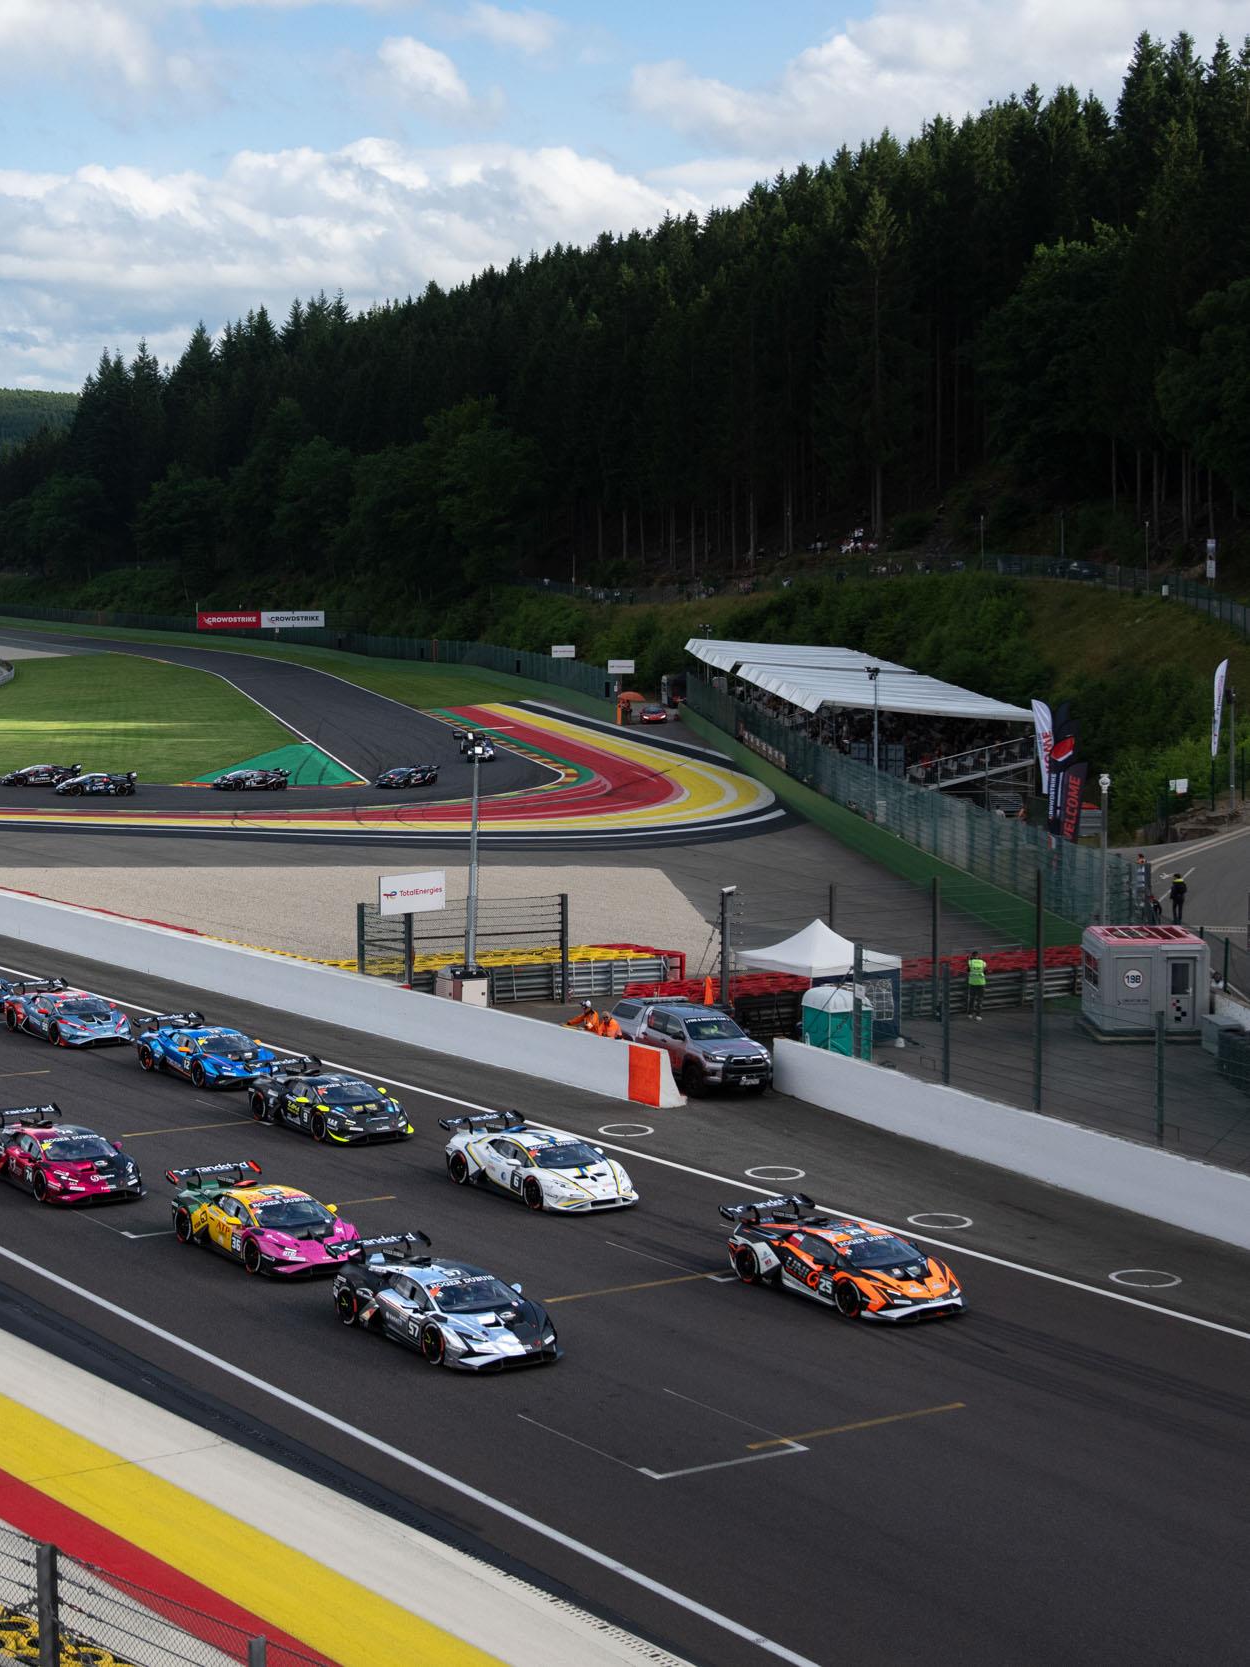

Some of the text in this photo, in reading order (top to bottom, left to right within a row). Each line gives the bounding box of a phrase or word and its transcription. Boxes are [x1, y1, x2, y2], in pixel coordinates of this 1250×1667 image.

[399, 886, 443, 897] TotalEnergies
[513, 1176, 520, 1188] 6
[231, 1236, 241, 1251] 36
[430, 1274, 495, 1289] ROGER DUBUIS
[819, 1278, 833, 1294] 25
[408, 1319, 419, 1338] 57
